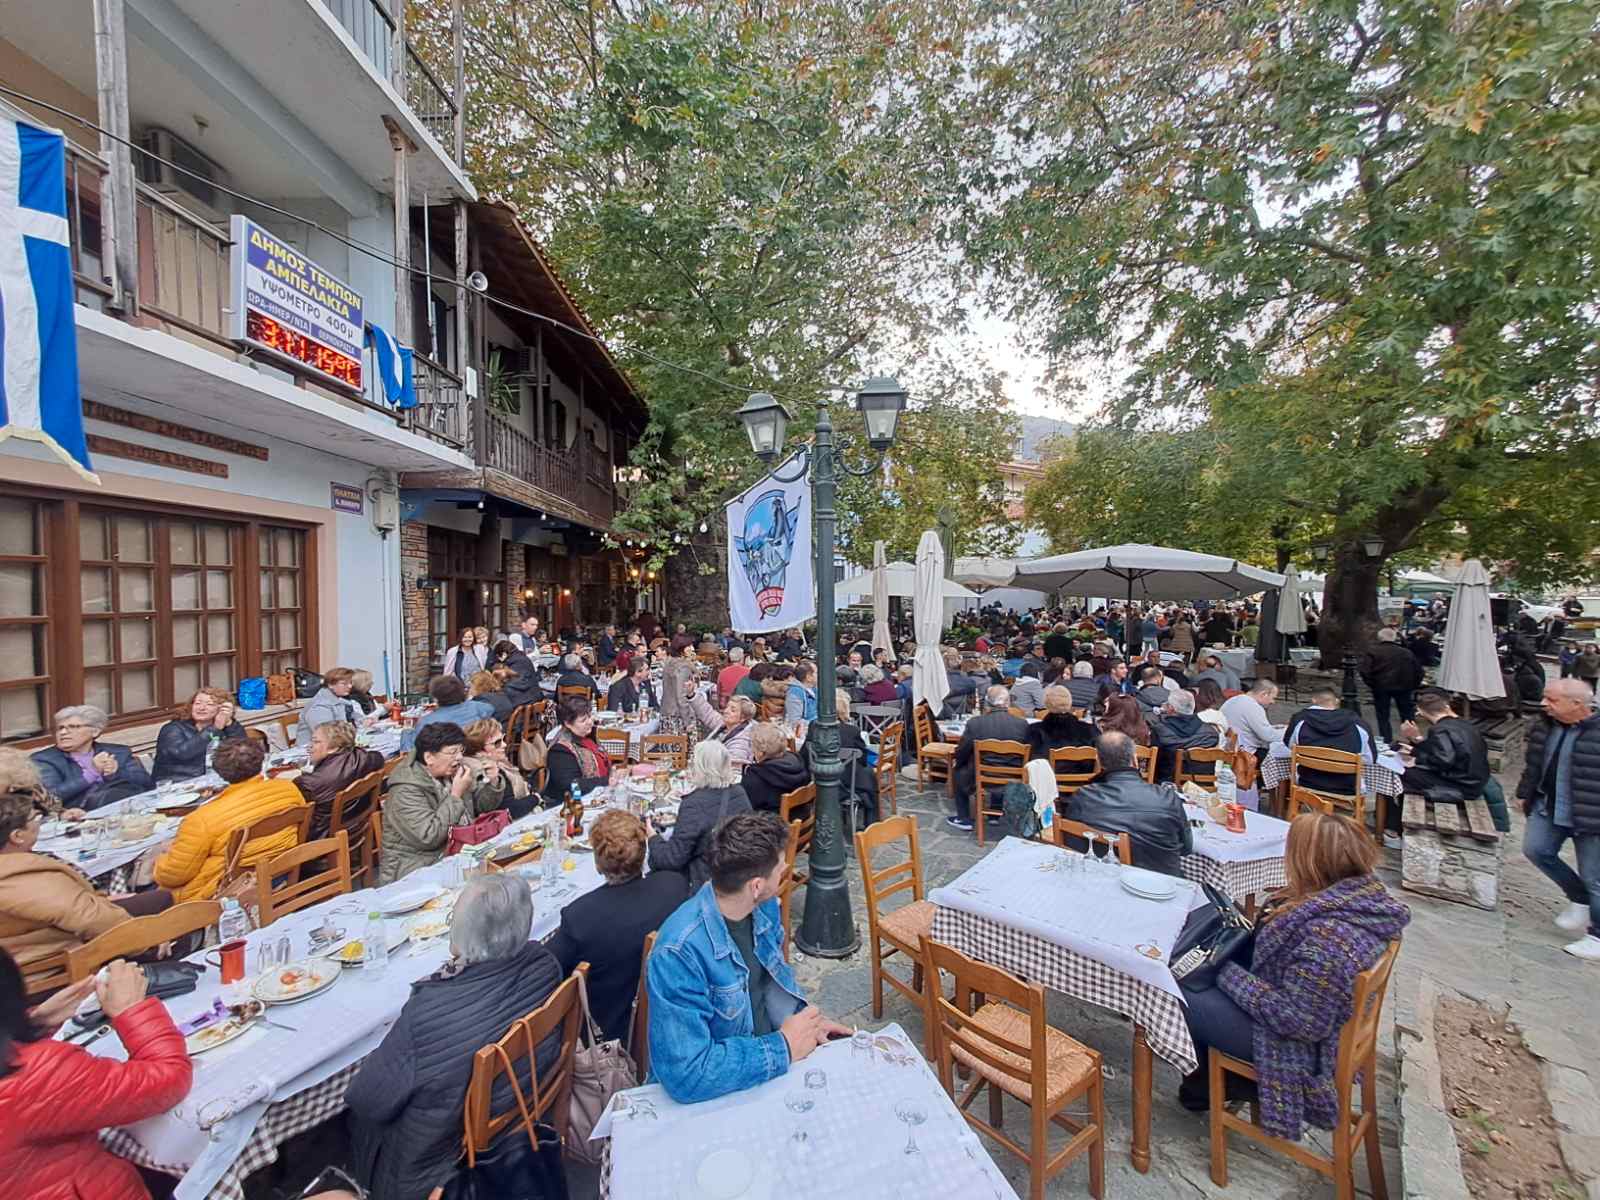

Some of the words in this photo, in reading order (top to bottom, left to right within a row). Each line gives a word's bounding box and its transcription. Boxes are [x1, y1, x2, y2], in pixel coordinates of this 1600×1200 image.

[250, 231, 306, 275] ΔΗΜΟΣ
[309, 267, 361, 310] ΤΕΜΠΩΝ
[261, 275, 321, 319] ΥΨΟΜΕΤΡΟ
[266, 258, 350, 319] ΑΜΠΕΛΑΚΙΑ
